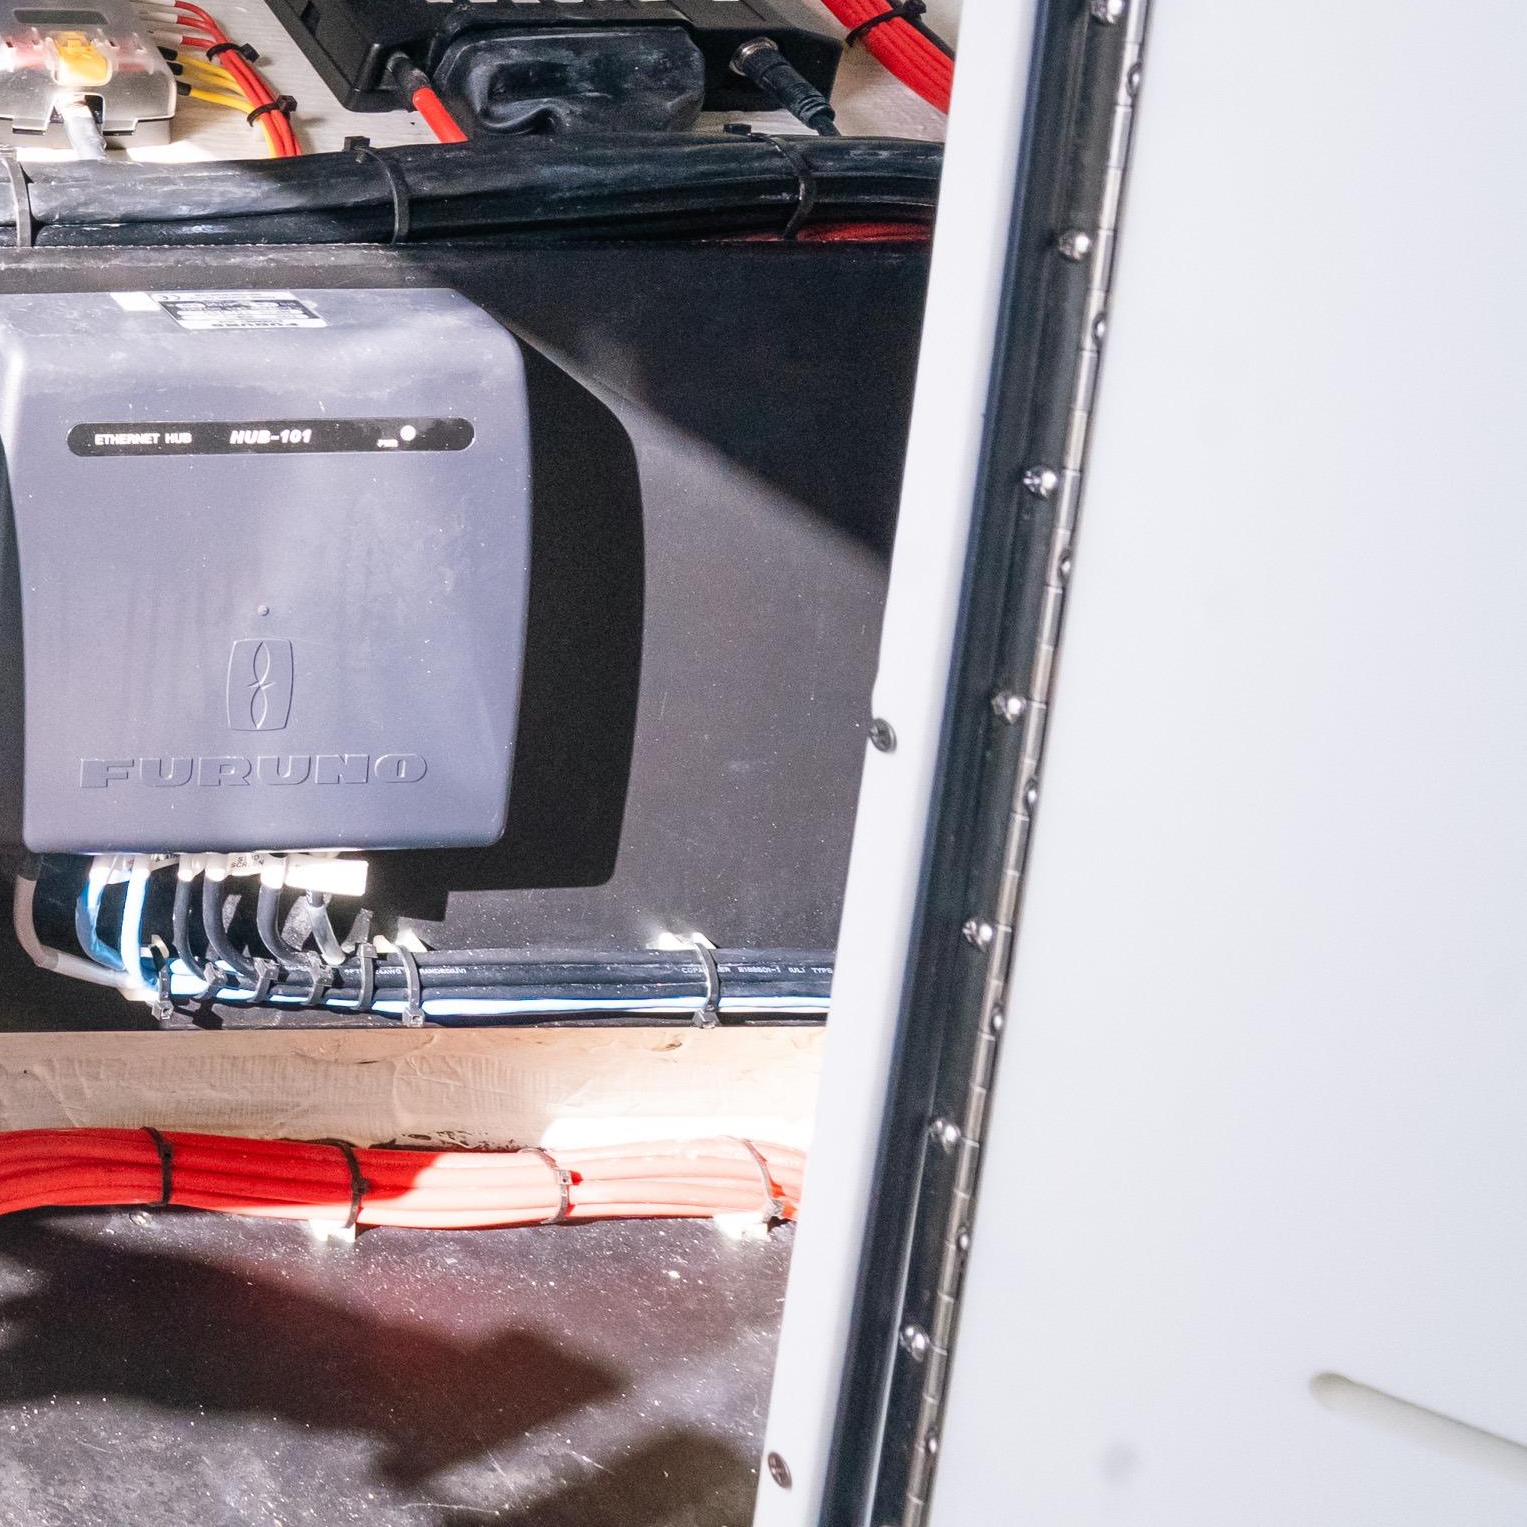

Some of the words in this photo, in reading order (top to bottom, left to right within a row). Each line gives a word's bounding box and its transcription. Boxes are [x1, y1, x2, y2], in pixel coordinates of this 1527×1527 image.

[94, 433, 160, 446] ETHERNET
[164, 432, 192, 445] HUB
[230, 429, 313, 445] HUB-101
[79, 753, 431, 790] FURUNO
